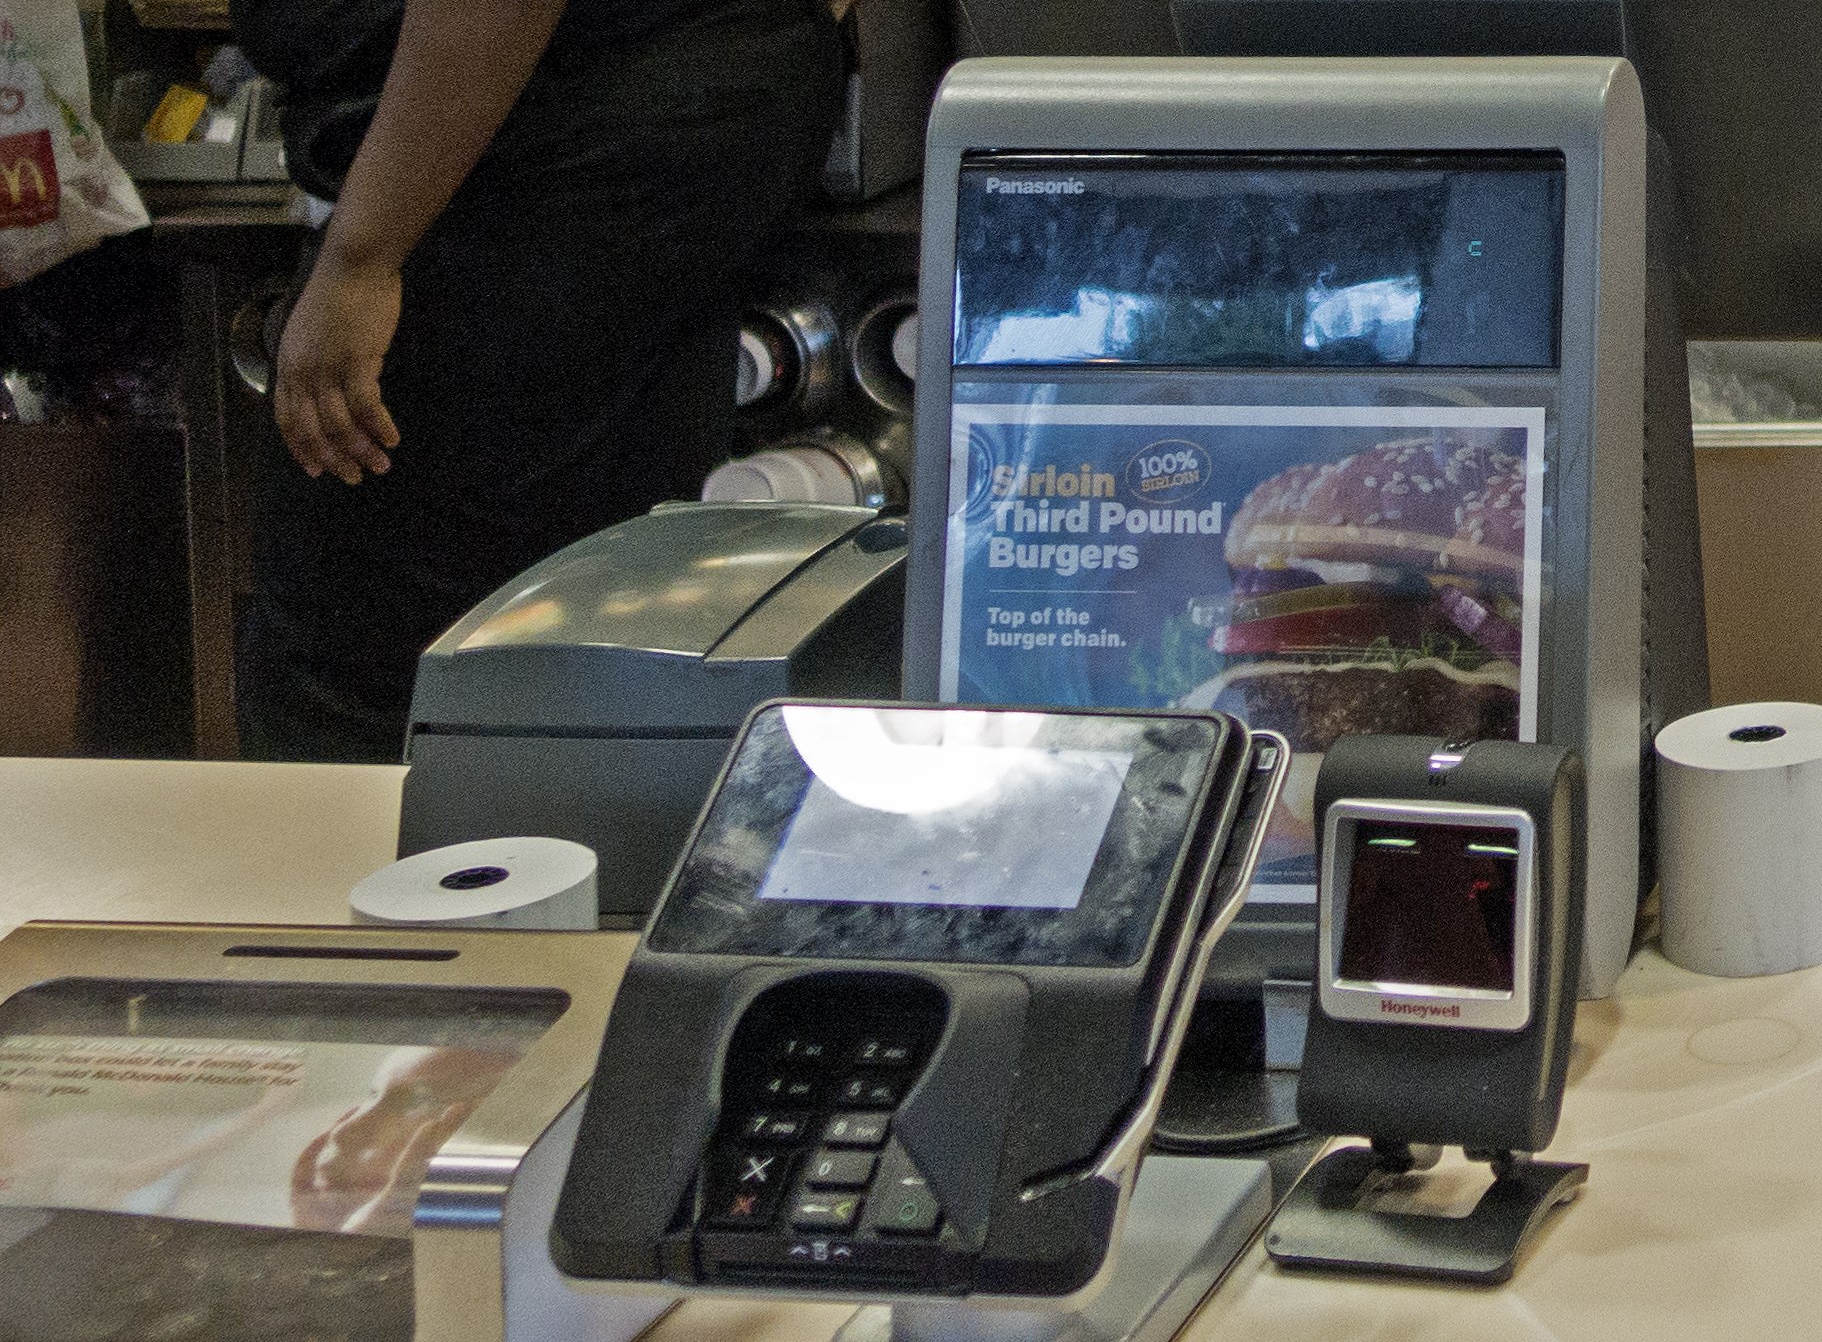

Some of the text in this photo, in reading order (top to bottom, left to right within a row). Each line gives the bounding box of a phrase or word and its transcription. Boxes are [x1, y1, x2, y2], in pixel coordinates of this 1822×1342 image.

[986, 177, 1085, 196] Panasonic
[1139, 449, 1199, 478] 100%
[991, 464, 1116, 498] Sirloin
[992, 501, 1223, 534] Third Pound
[988, 538, 1139, 577] Burgers
[988, 606, 1090, 628] Top of the
[986, 628, 1127, 651] burger chain.
[1380, 998, 1461, 1019] Honeywell
[864, 1041, 878, 1058] 2
